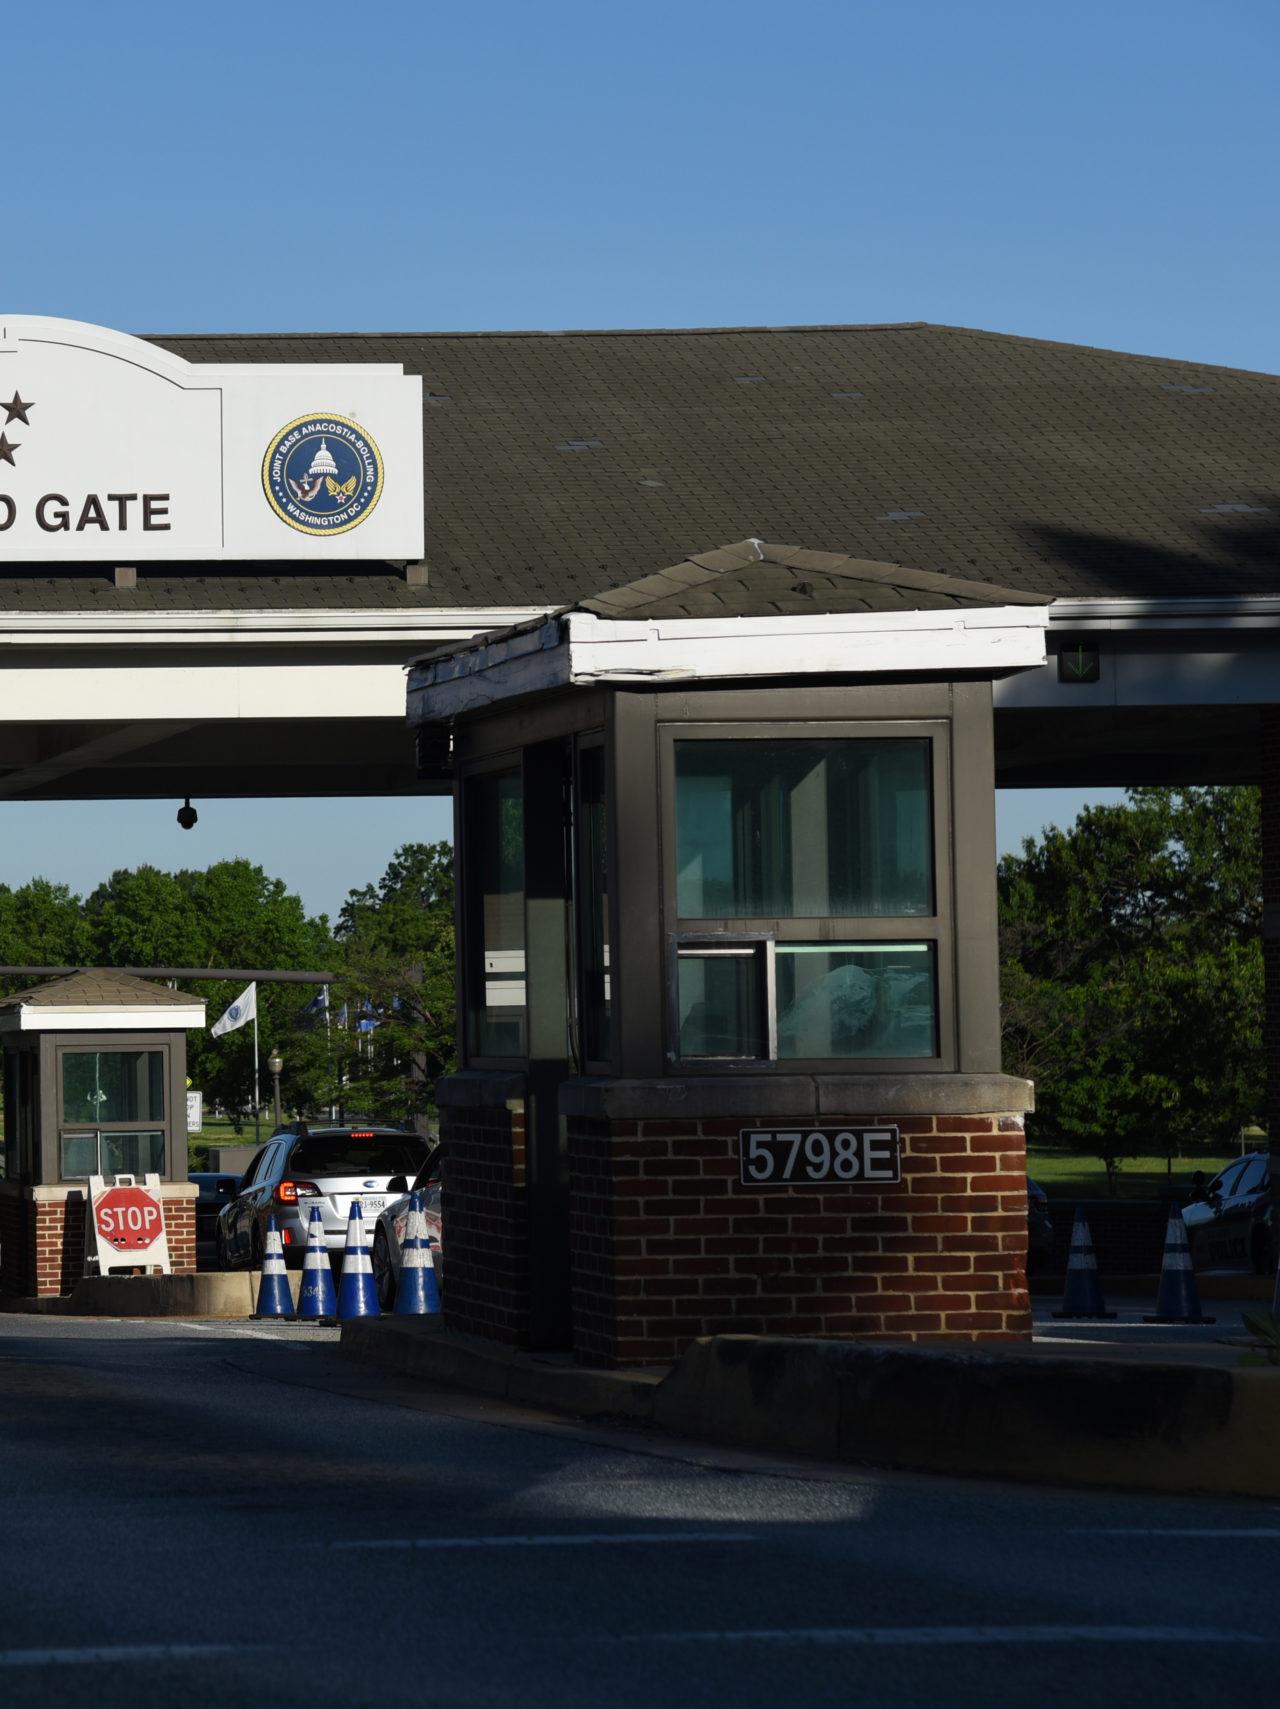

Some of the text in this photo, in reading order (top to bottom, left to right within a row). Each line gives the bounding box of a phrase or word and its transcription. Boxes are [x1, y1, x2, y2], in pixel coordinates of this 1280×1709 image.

[272, 423, 374, 483] JOINT BASE ANACOSTIA-BOLLING
[35, 493, 171, 533] GATE
[286, 502, 361, 526] WASHINGTON DC
[748, 1132, 894, 1180] 5798E
[99, 1206, 158, 1232] STOP
